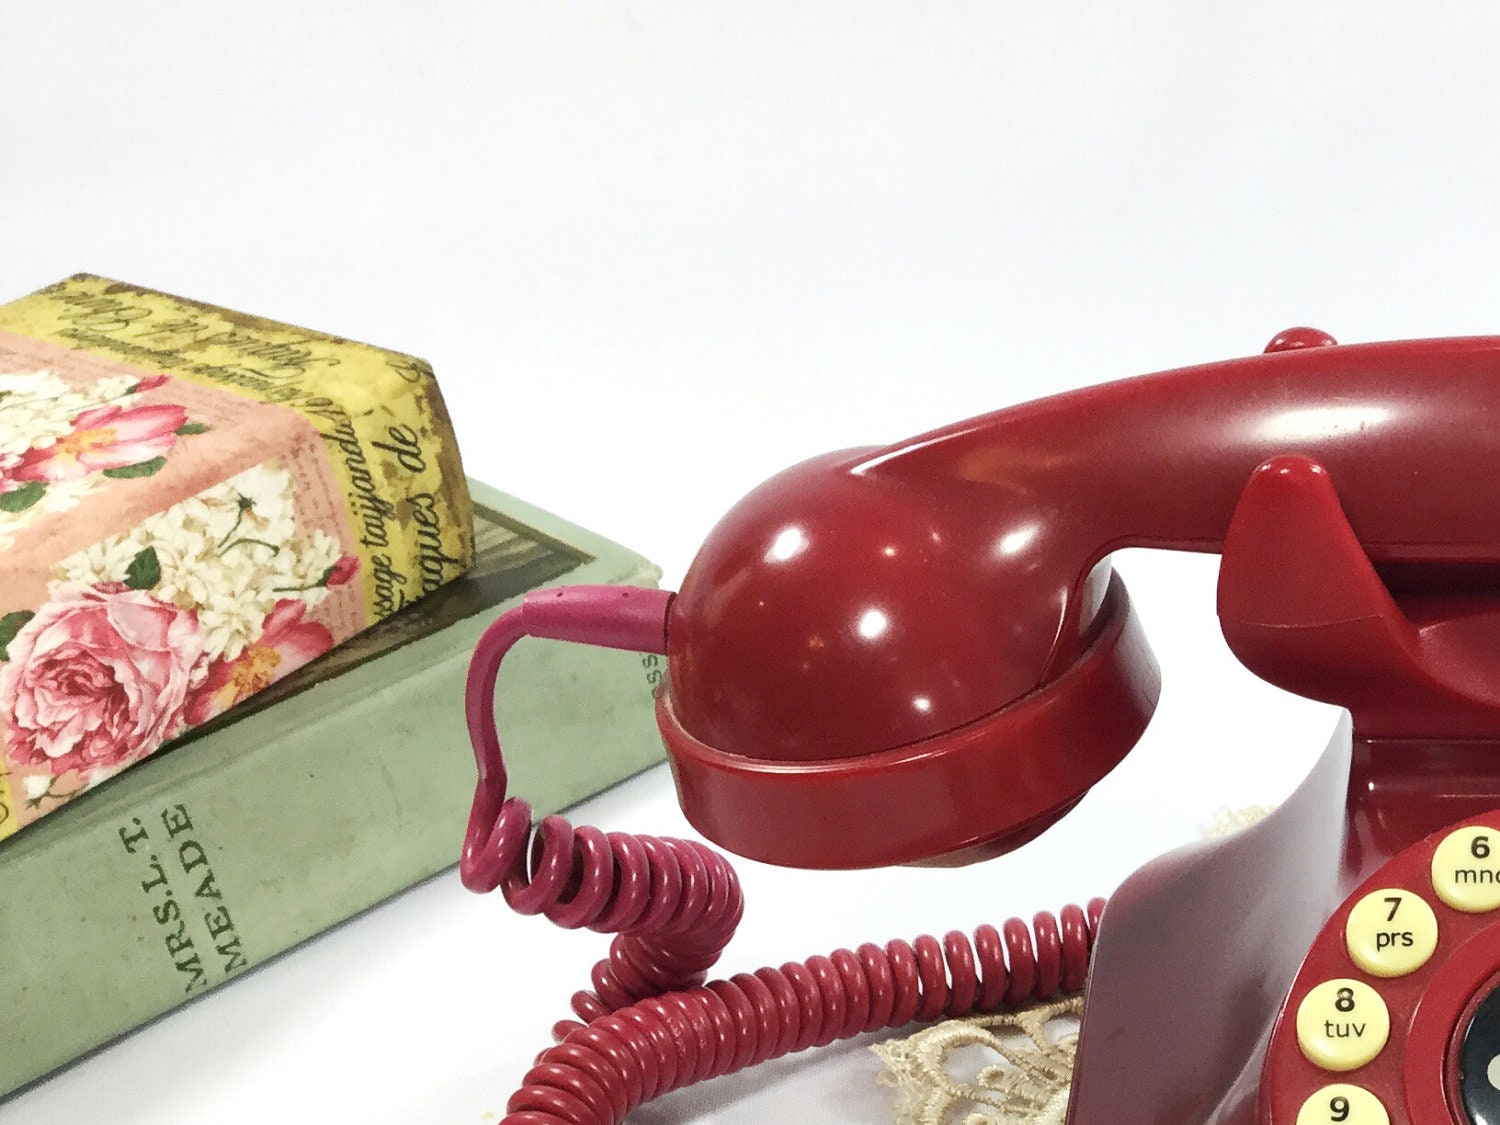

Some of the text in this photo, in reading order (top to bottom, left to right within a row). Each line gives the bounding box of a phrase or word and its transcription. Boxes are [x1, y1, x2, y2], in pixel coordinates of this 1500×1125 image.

[371, 423, 426, 473] de
[1470, 835, 1490, 859] 6
[161, 804, 247, 973] MEADE
[1384, 897, 1402, 922] 7
[1376, 931, 1414, 952] prs
[1334, 988, 1355, 1012] 8
[1324, 1018, 1366, 1039] tuv
[1330, 1097, 1349, 1122] 9
